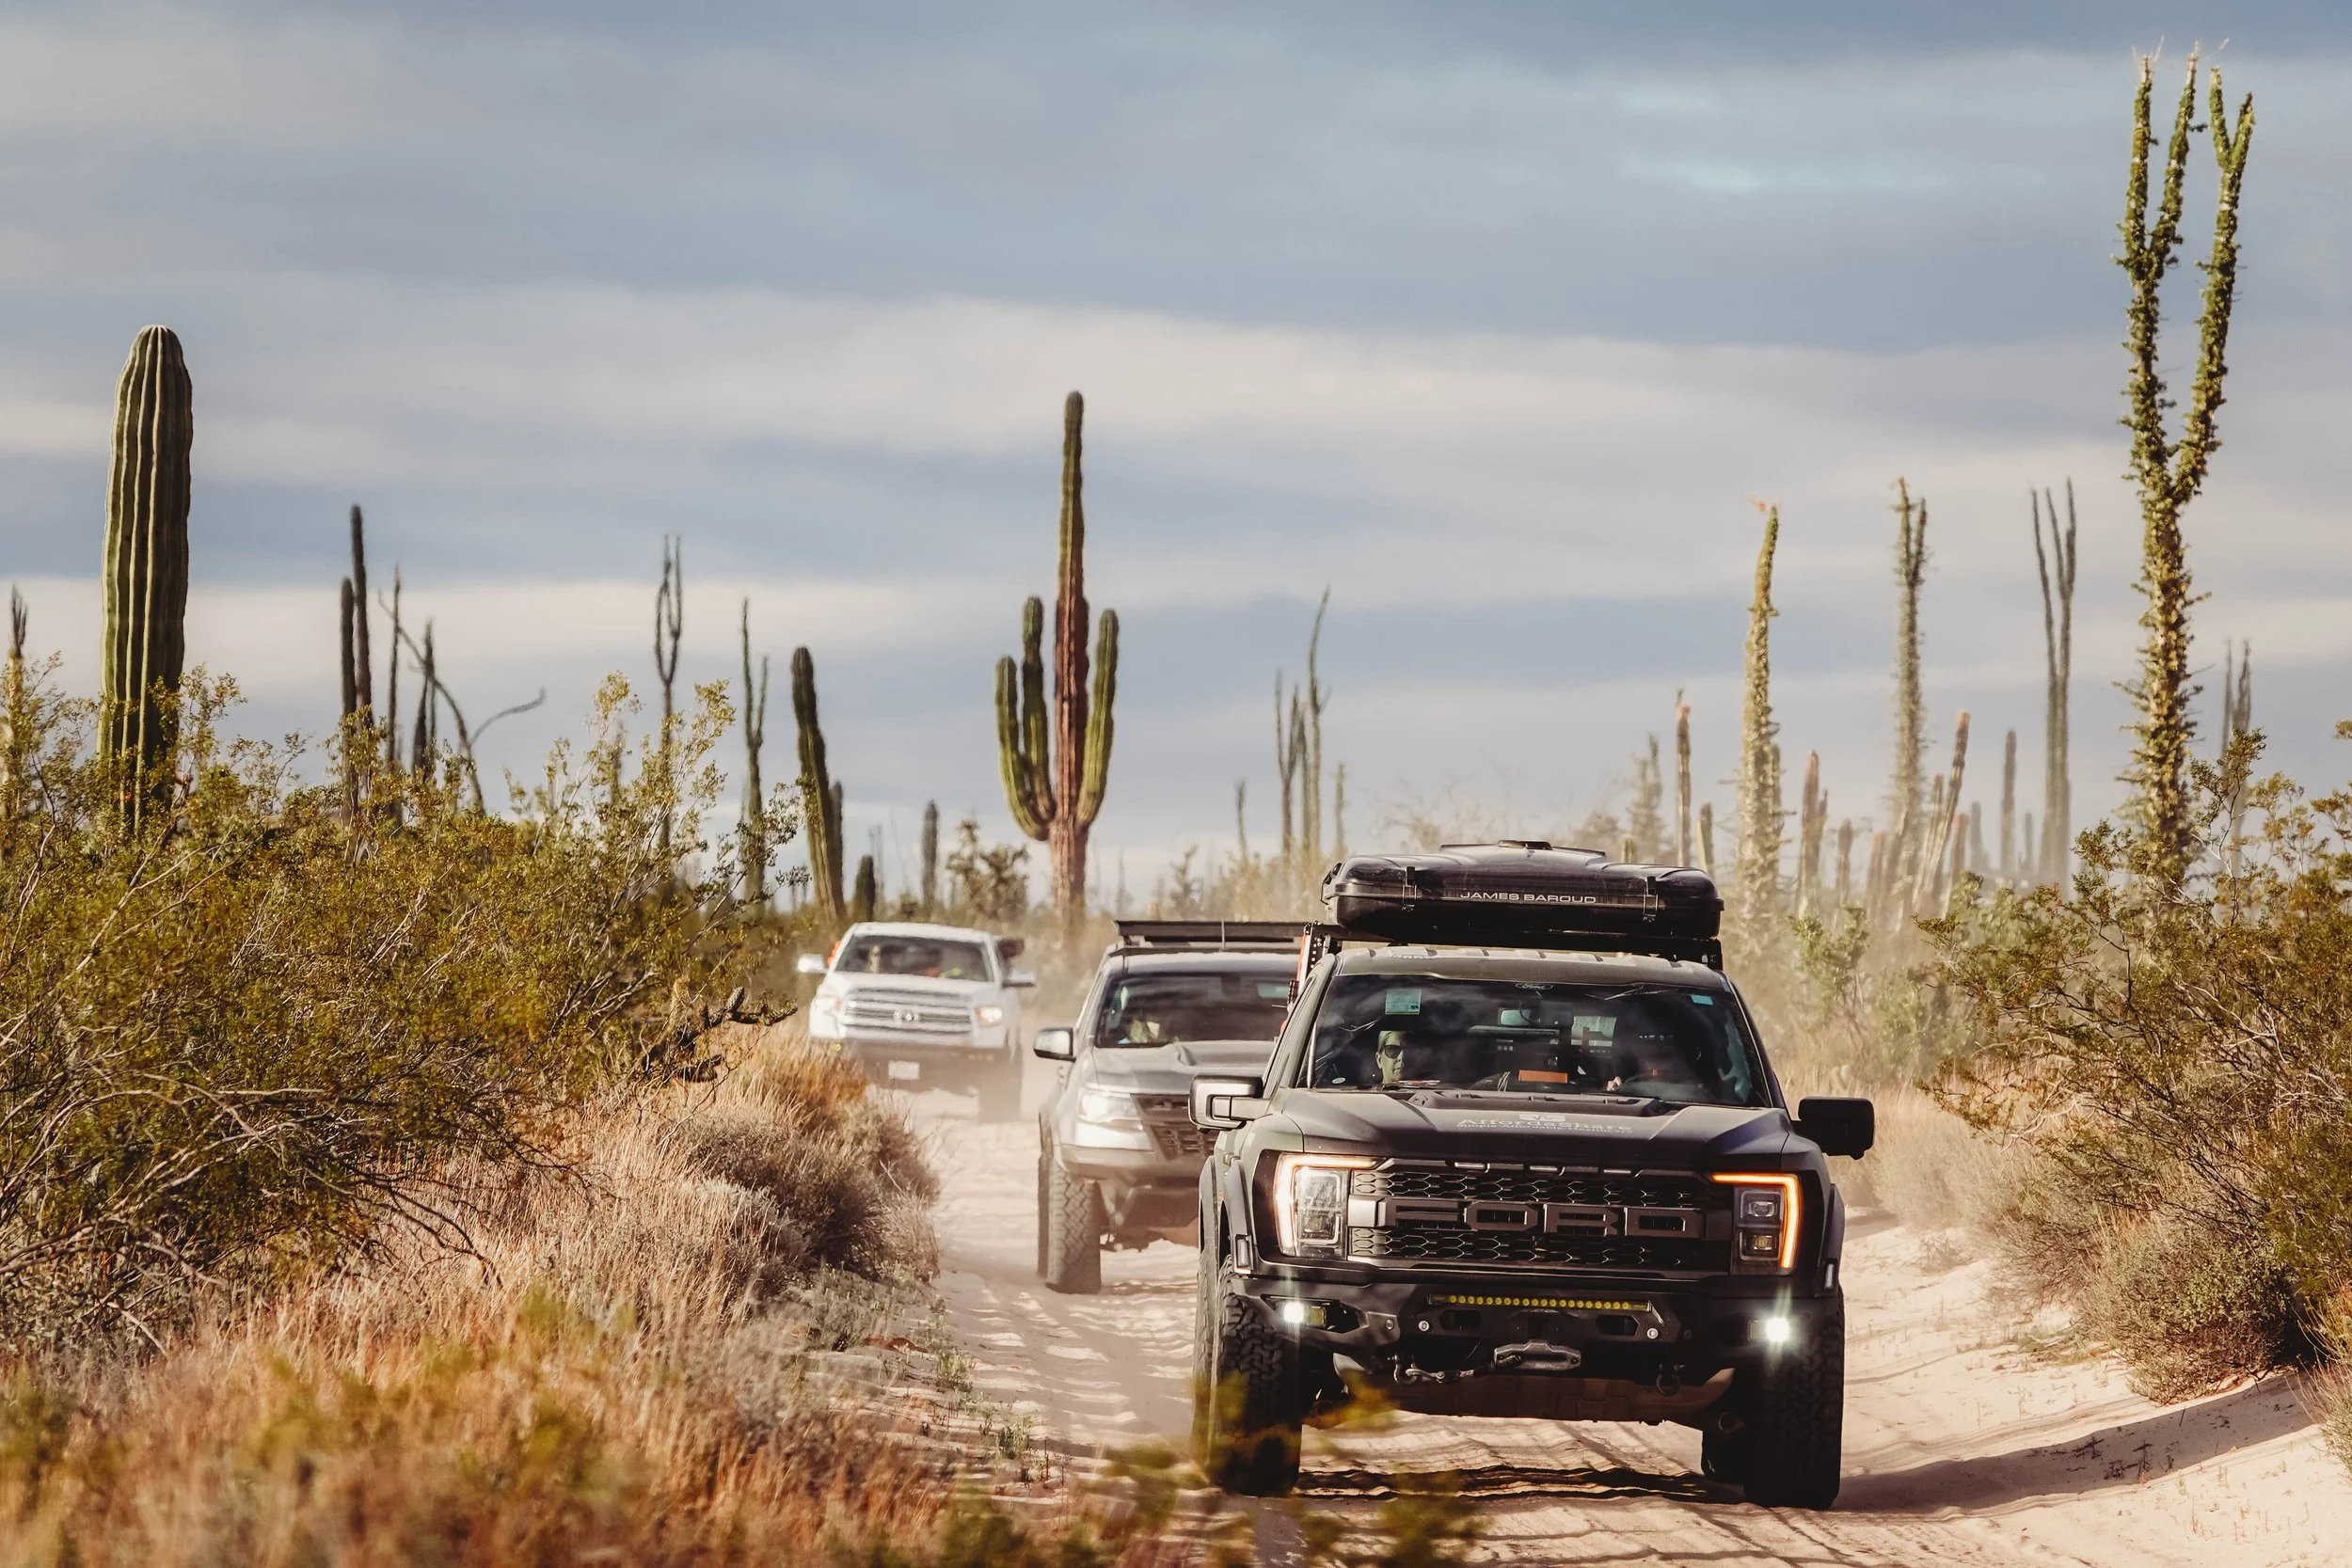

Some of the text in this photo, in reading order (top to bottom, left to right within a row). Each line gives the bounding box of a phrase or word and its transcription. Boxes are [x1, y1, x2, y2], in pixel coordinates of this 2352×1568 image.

[1460, 892, 1597, 903] JAMES BAROUD
[1379, 1197, 1705, 1239] FORD
